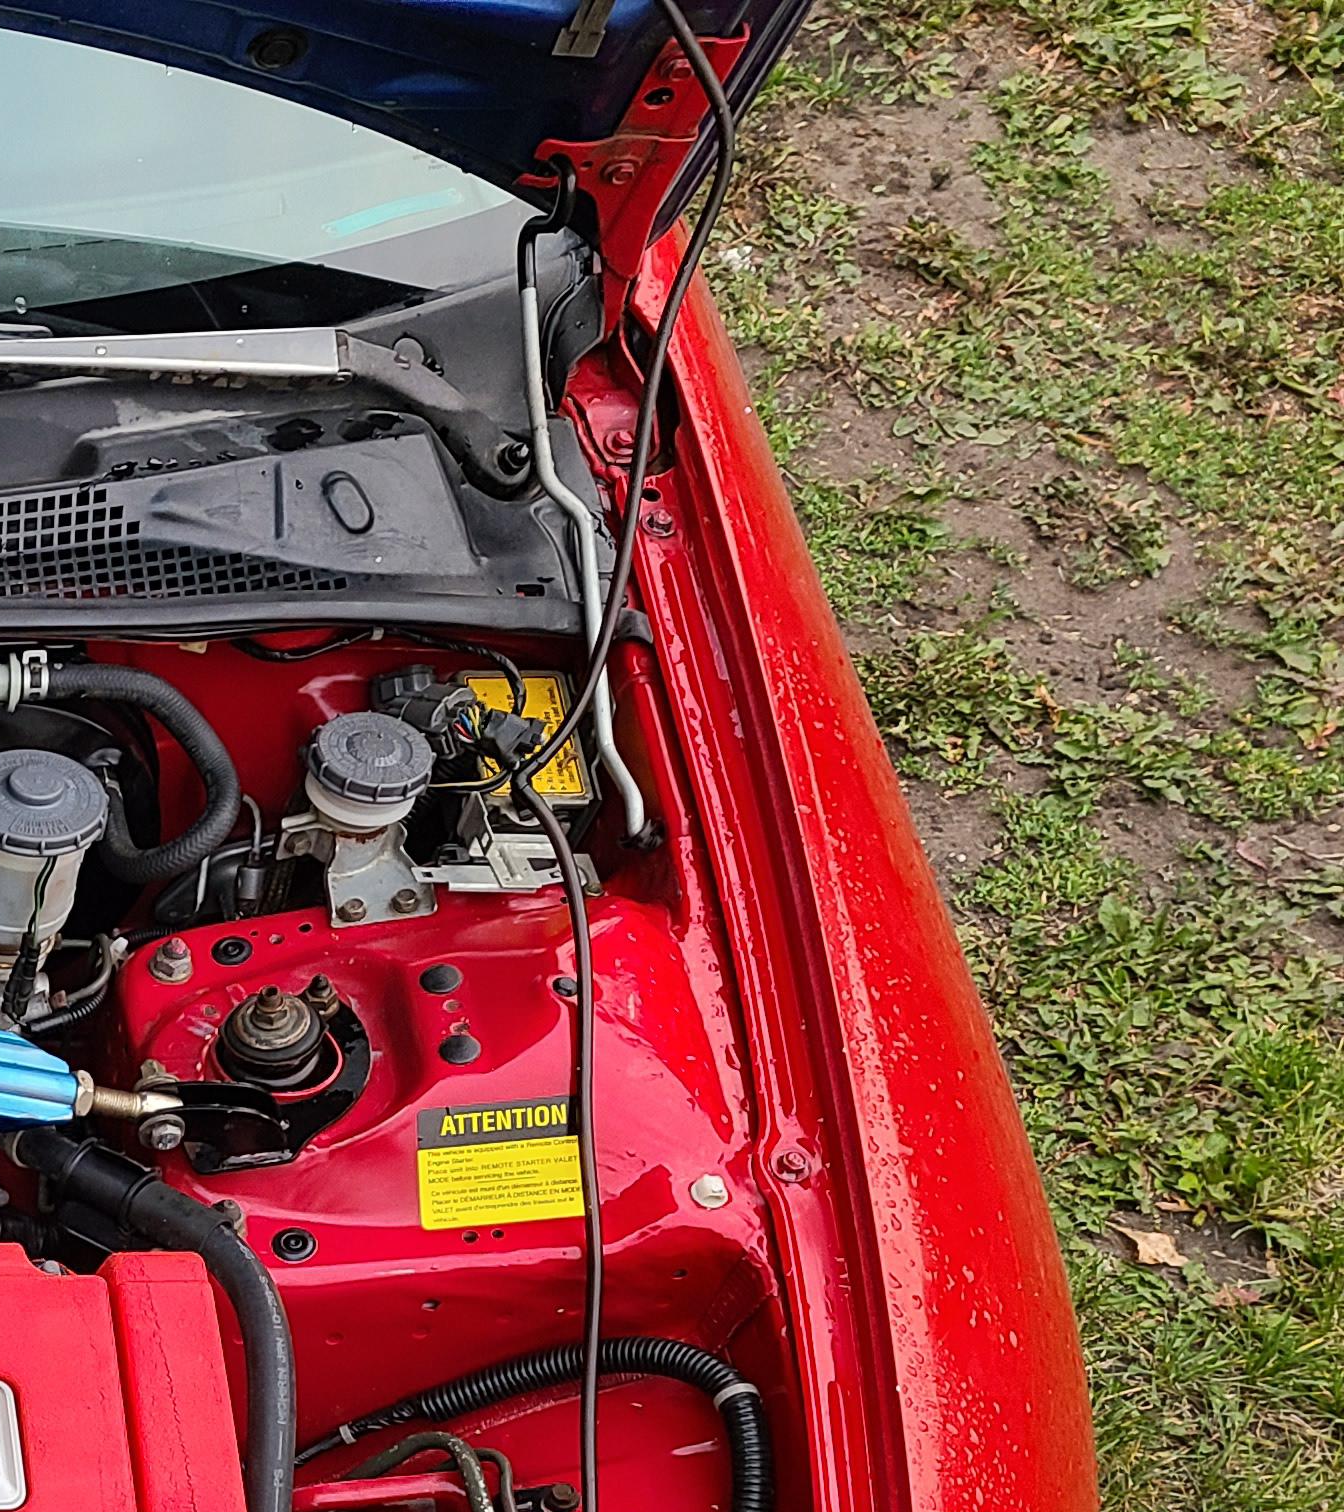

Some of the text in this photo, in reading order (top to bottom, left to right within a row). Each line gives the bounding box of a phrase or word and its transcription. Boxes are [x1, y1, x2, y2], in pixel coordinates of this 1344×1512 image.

[440, 1104, 567, 1136] ATTENTION
[474, 1146, 504, 1154] equipped
[428, 1159, 450, 1167] Engine
[481, 1161, 513, 1170] REMOTE
[517, 1159, 551, 1167] STARTER
[554, 1155, 577, 1163] VALET
[460, 1193, 505, 1203] DÉMARREUR
[513, 1189, 546, 1198] DISTANCE
